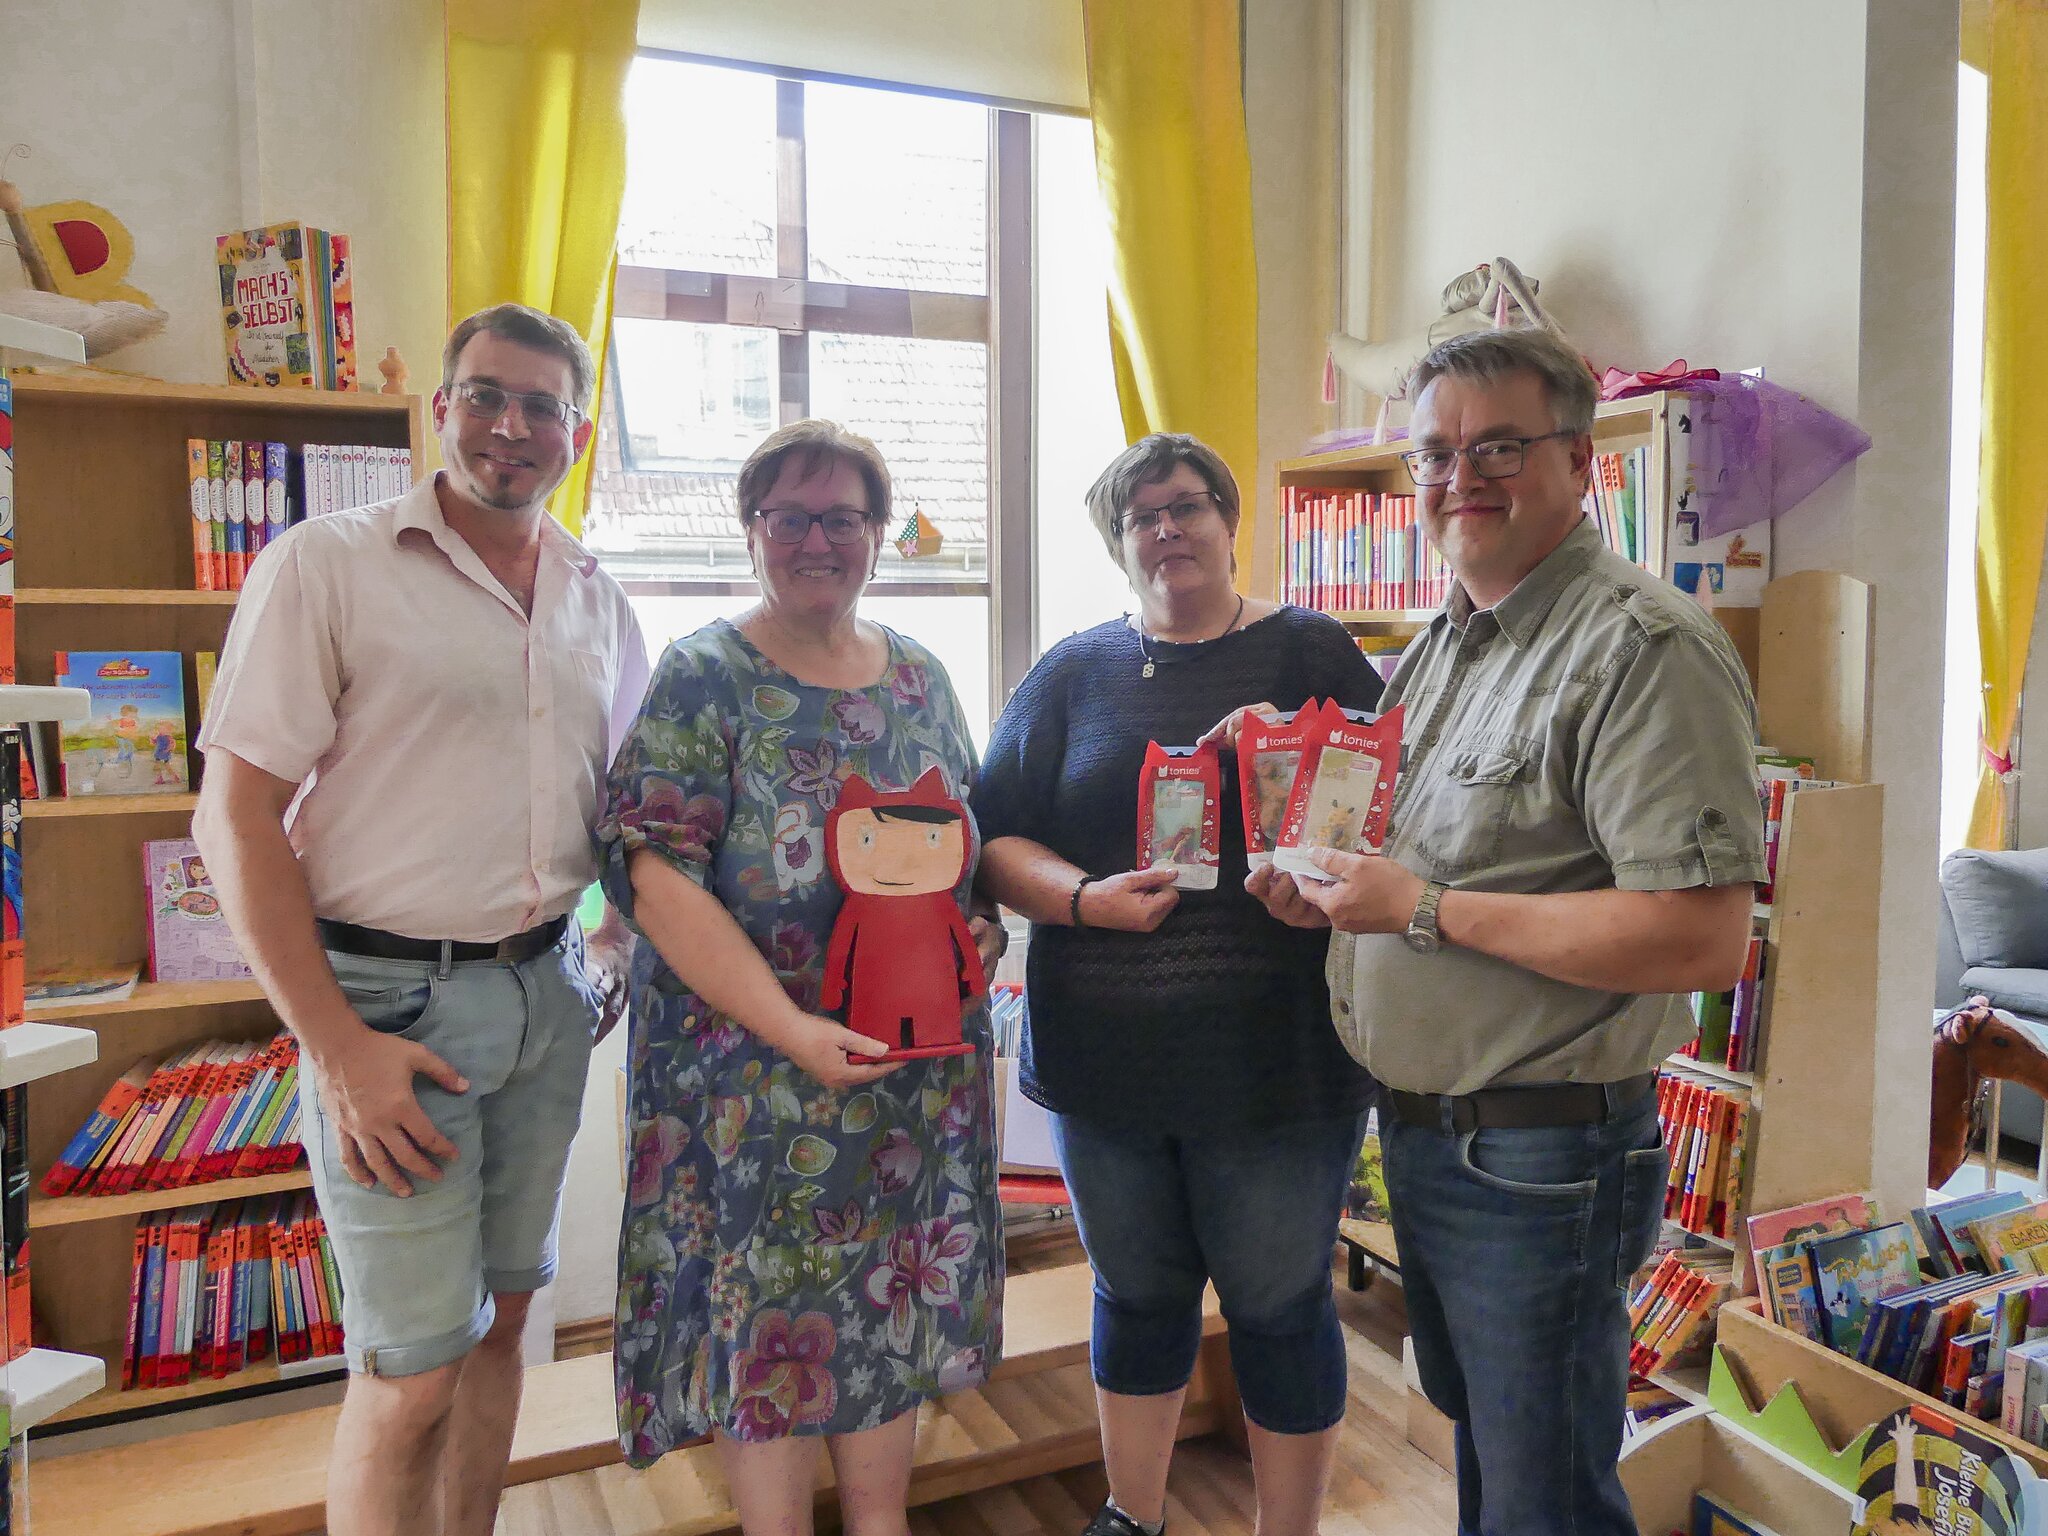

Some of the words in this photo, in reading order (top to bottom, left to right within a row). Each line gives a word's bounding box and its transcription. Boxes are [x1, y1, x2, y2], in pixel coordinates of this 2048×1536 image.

[237, 271, 288, 304] MACH'S
[242, 298, 294, 329] SELBST
[1269, 735, 1303, 747] tonies
[1343, 733, 1379, 750] tonies
[1169, 765, 1199, 775] tonies
[1957, 1448, 1982, 1508] Kleine
